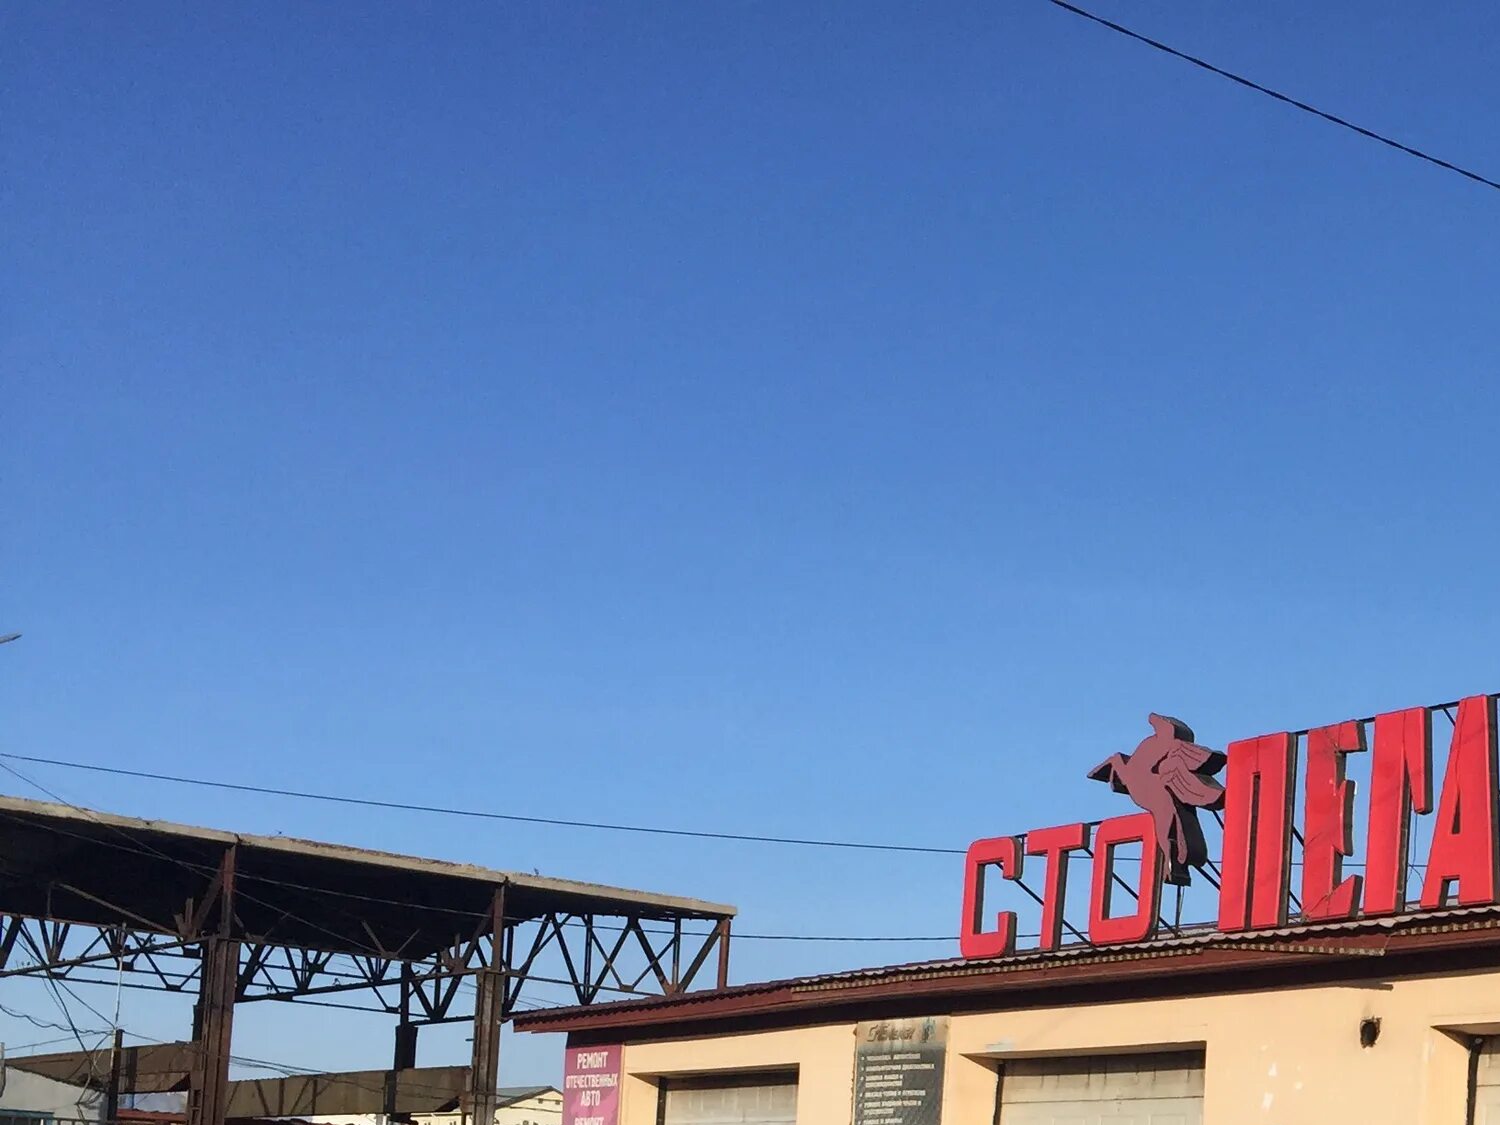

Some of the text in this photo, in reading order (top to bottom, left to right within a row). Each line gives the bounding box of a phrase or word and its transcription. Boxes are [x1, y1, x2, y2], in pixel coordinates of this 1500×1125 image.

[960, 813, 1162, 960] СТО
[577, 1051, 608, 1069] РЕМОНТ
[566, 1073, 618, 1089] ОТЕЧЕСТВЕННЫХ
[581, 1090, 601, 1106] АВТО
